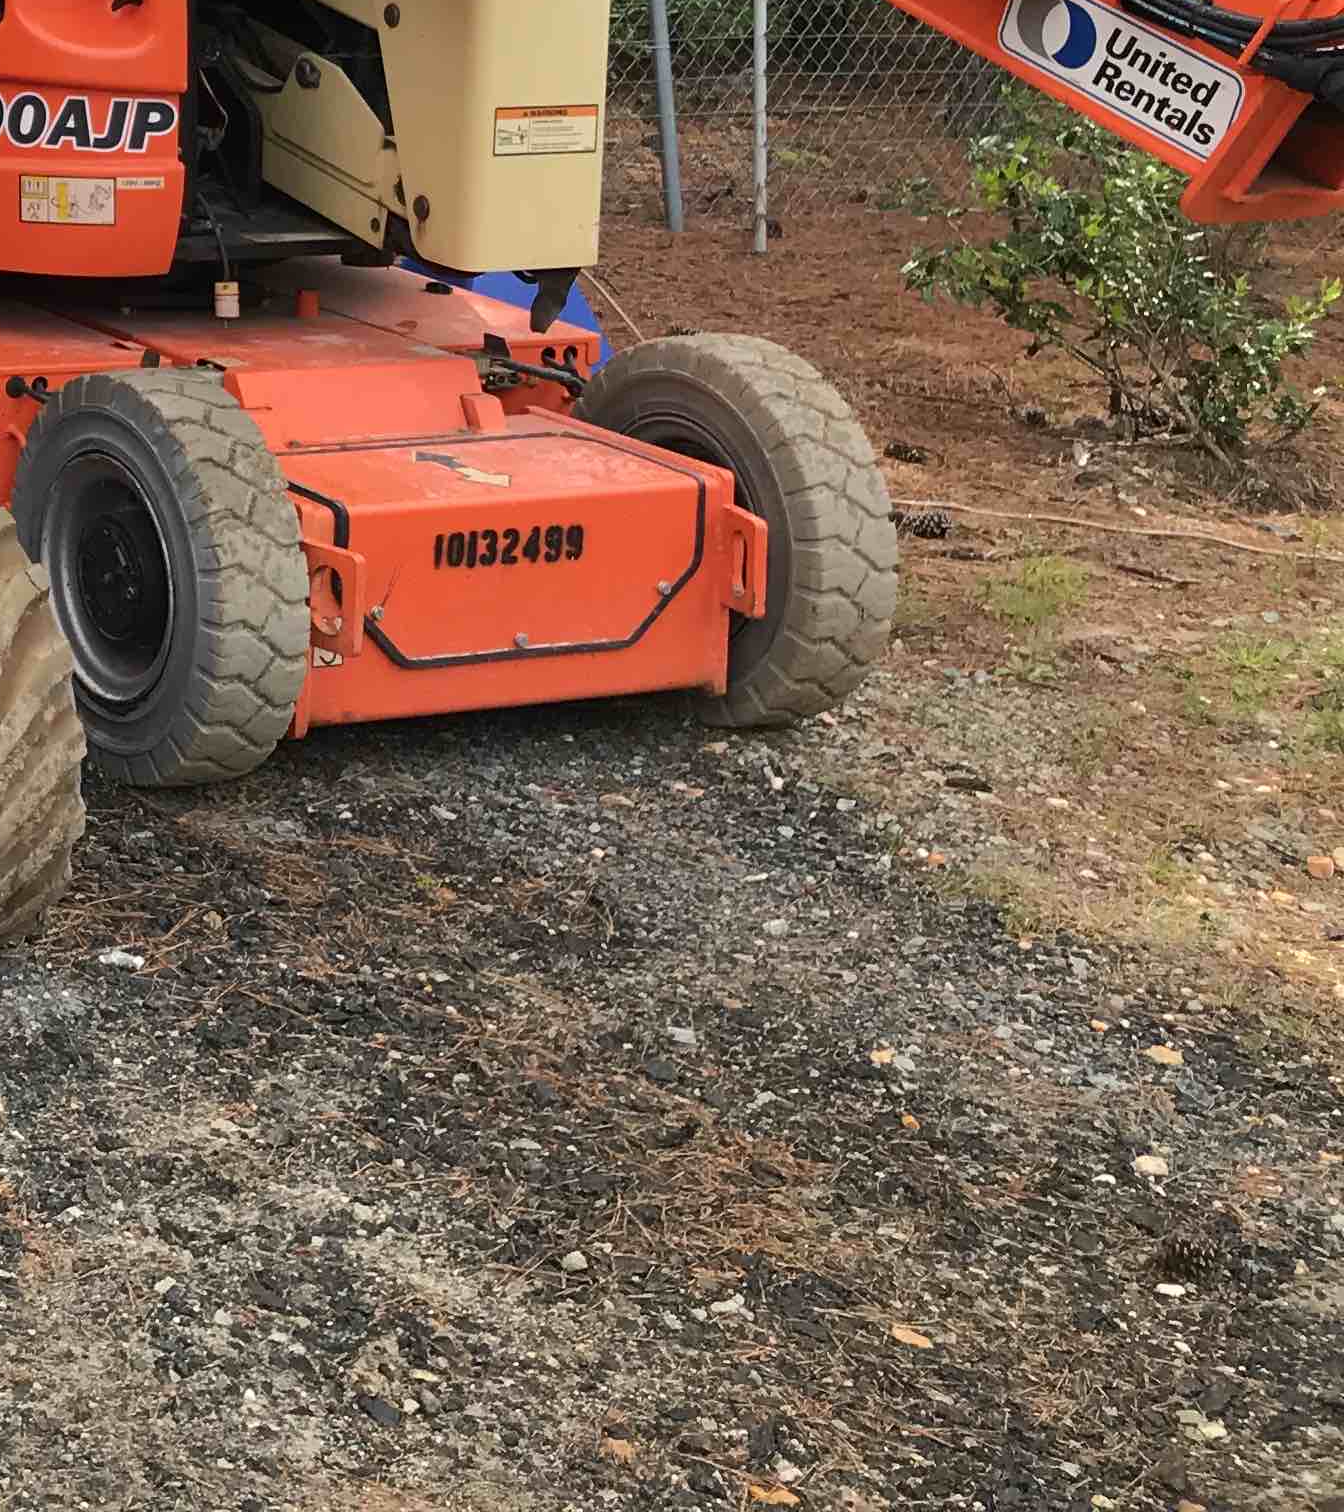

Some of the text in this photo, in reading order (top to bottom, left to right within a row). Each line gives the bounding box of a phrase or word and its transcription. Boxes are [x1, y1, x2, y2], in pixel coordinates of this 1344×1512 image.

[1091, 58, 1216, 146] Rentals
[1104, 27, 1221, 108] United
[434, 524, 584, 570] 10132499
